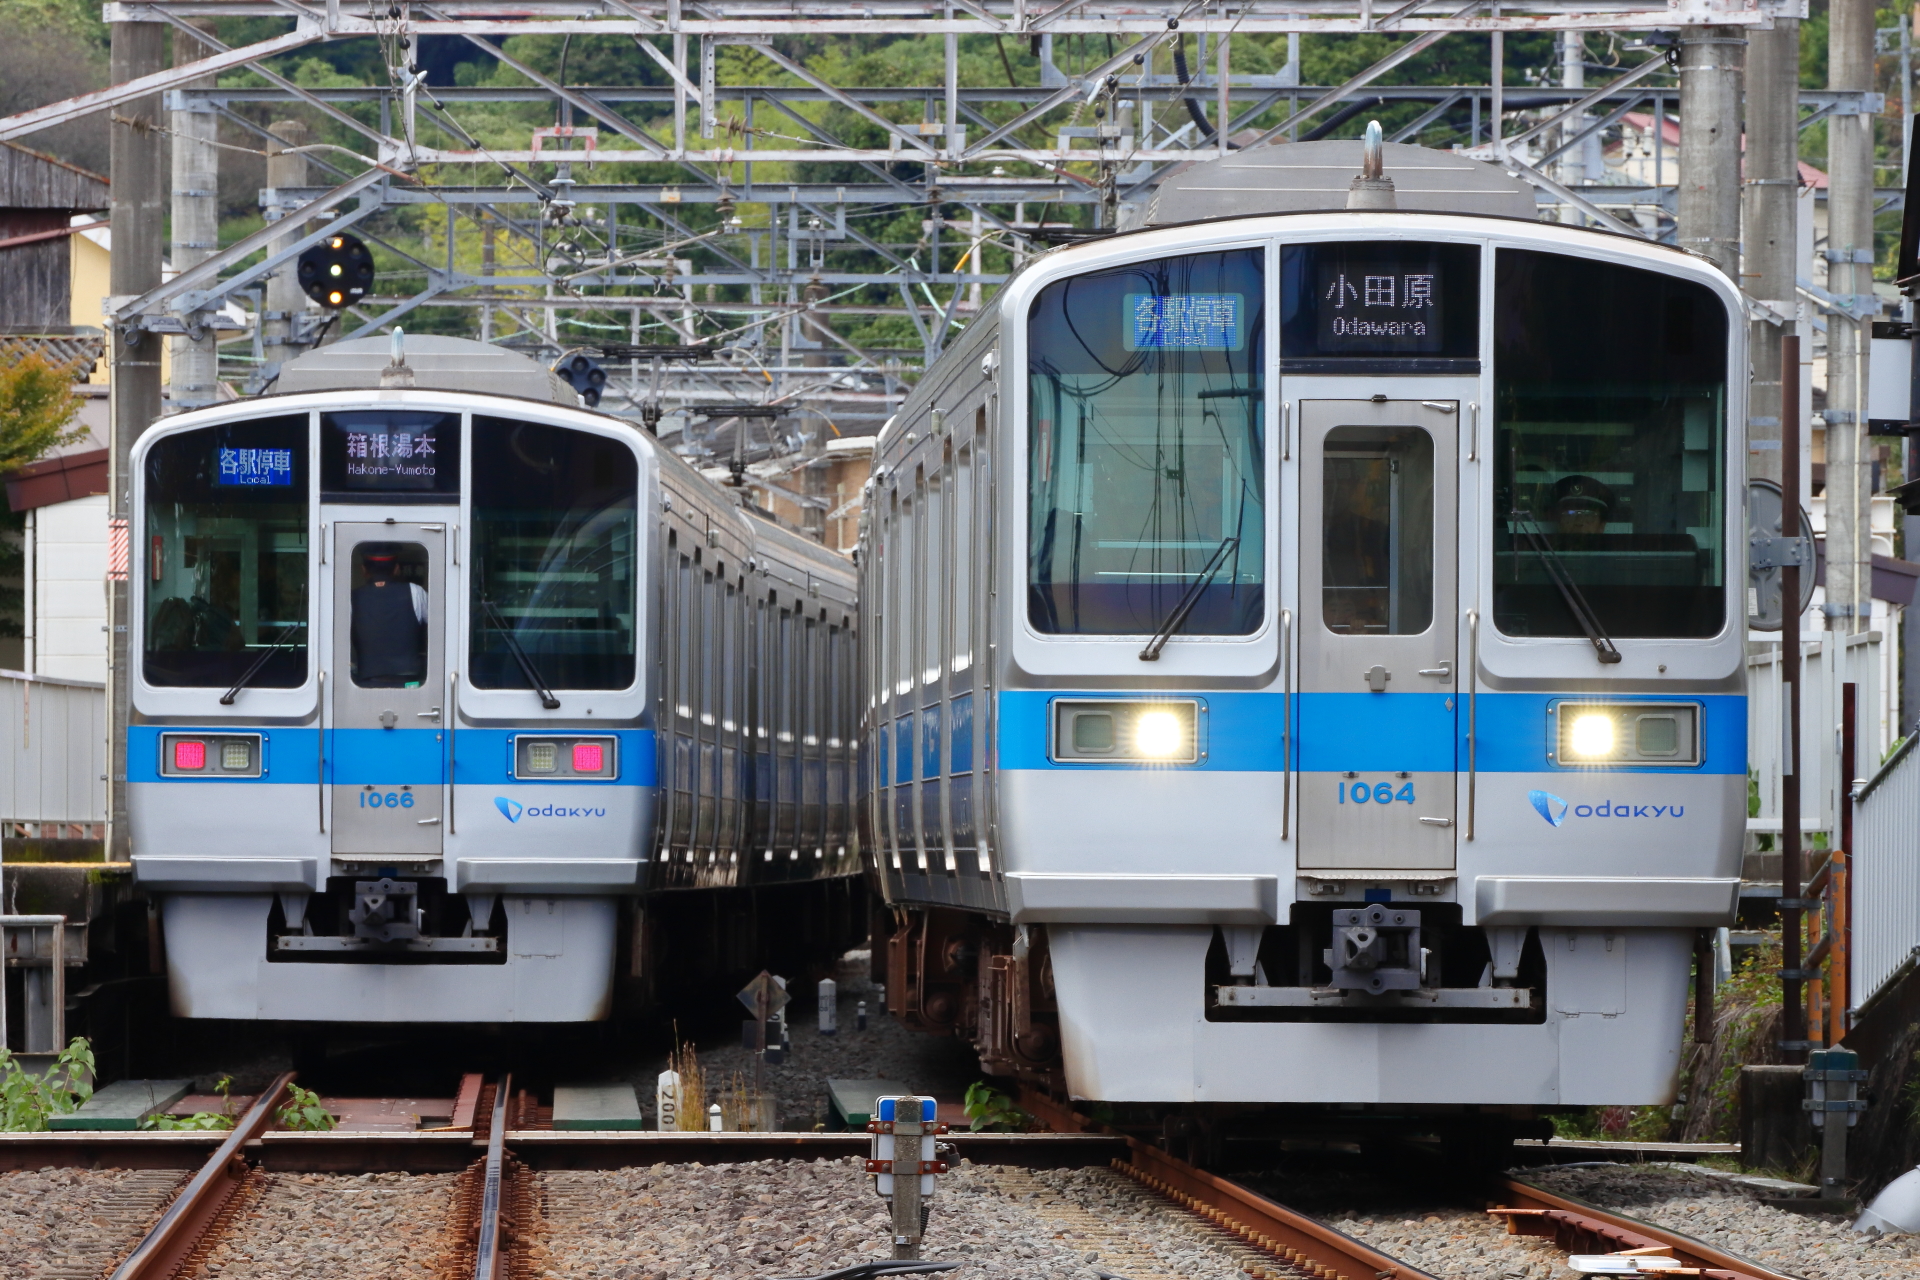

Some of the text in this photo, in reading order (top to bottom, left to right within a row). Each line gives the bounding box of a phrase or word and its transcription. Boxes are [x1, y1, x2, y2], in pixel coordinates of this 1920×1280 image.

[1325, 274, 1434, 309] 小田原
[1135, 296, 1235, 332] 各駅停車
[1333, 316, 1426, 336] Odawara
[1164, 333, 1208, 346] Local
[346, 432, 436, 459] 箱根湯本
[220, 448, 291, 475] 各駅停車
[348, 462, 436, 476] Hakone-Yumoto
[240, 474, 271, 484] Local
[360, 791, 415, 809] 1066
[1338, 782, 1416, 805] 1064
[661, 1090, 675, 1125] 200
